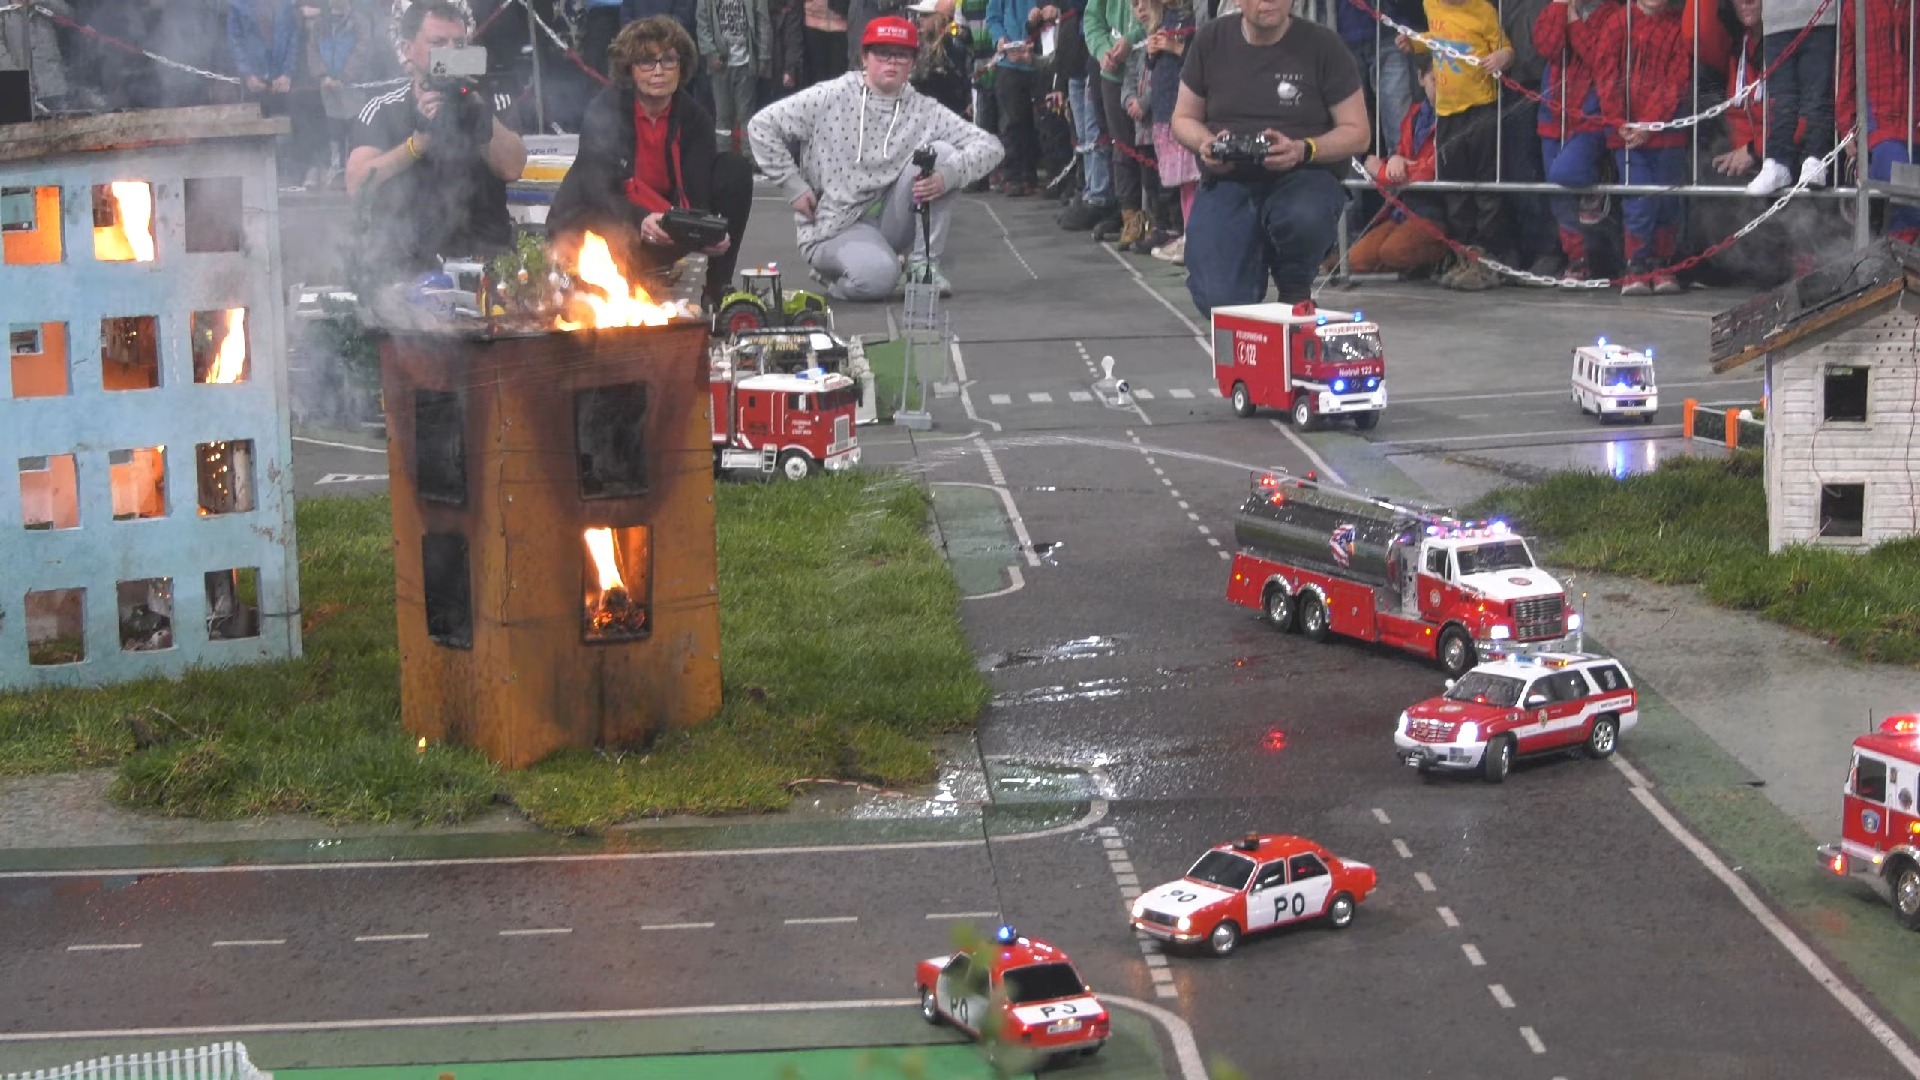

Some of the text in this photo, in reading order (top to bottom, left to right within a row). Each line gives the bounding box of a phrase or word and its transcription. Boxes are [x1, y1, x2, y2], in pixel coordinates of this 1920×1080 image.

[1246, 343, 1257, 366] 122
[1361, 366, 1373, 375] 122
[1273, 892, 1305, 923] PO
[951, 997, 969, 1024] PO
